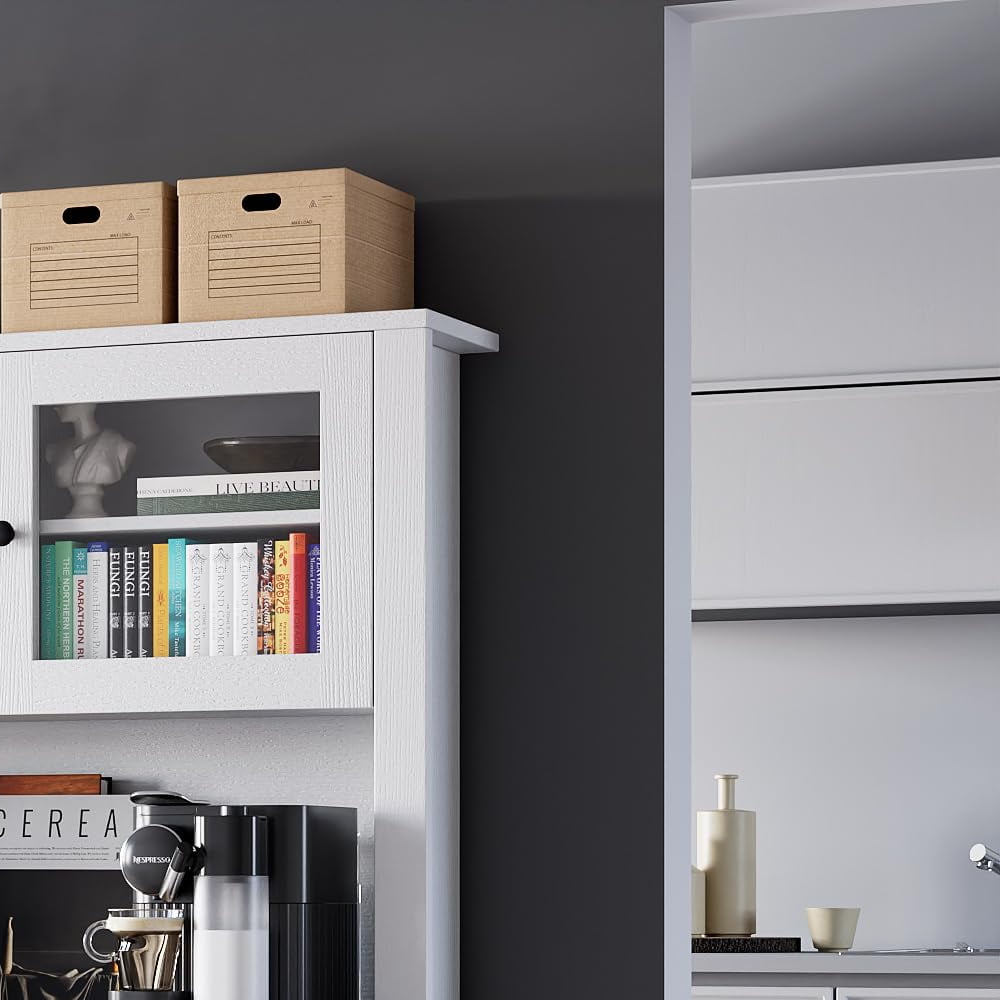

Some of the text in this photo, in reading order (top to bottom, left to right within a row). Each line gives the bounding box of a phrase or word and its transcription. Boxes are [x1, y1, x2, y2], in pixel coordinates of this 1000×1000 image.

[216, 482, 255, 495] LIVE
[111, 552, 120, 597] FUNGI
[126, 552, 135, 597] FUNGI
[141, 551, 150, 597] FUNGI
[133, 856, 170, 864] NESPRESSO
